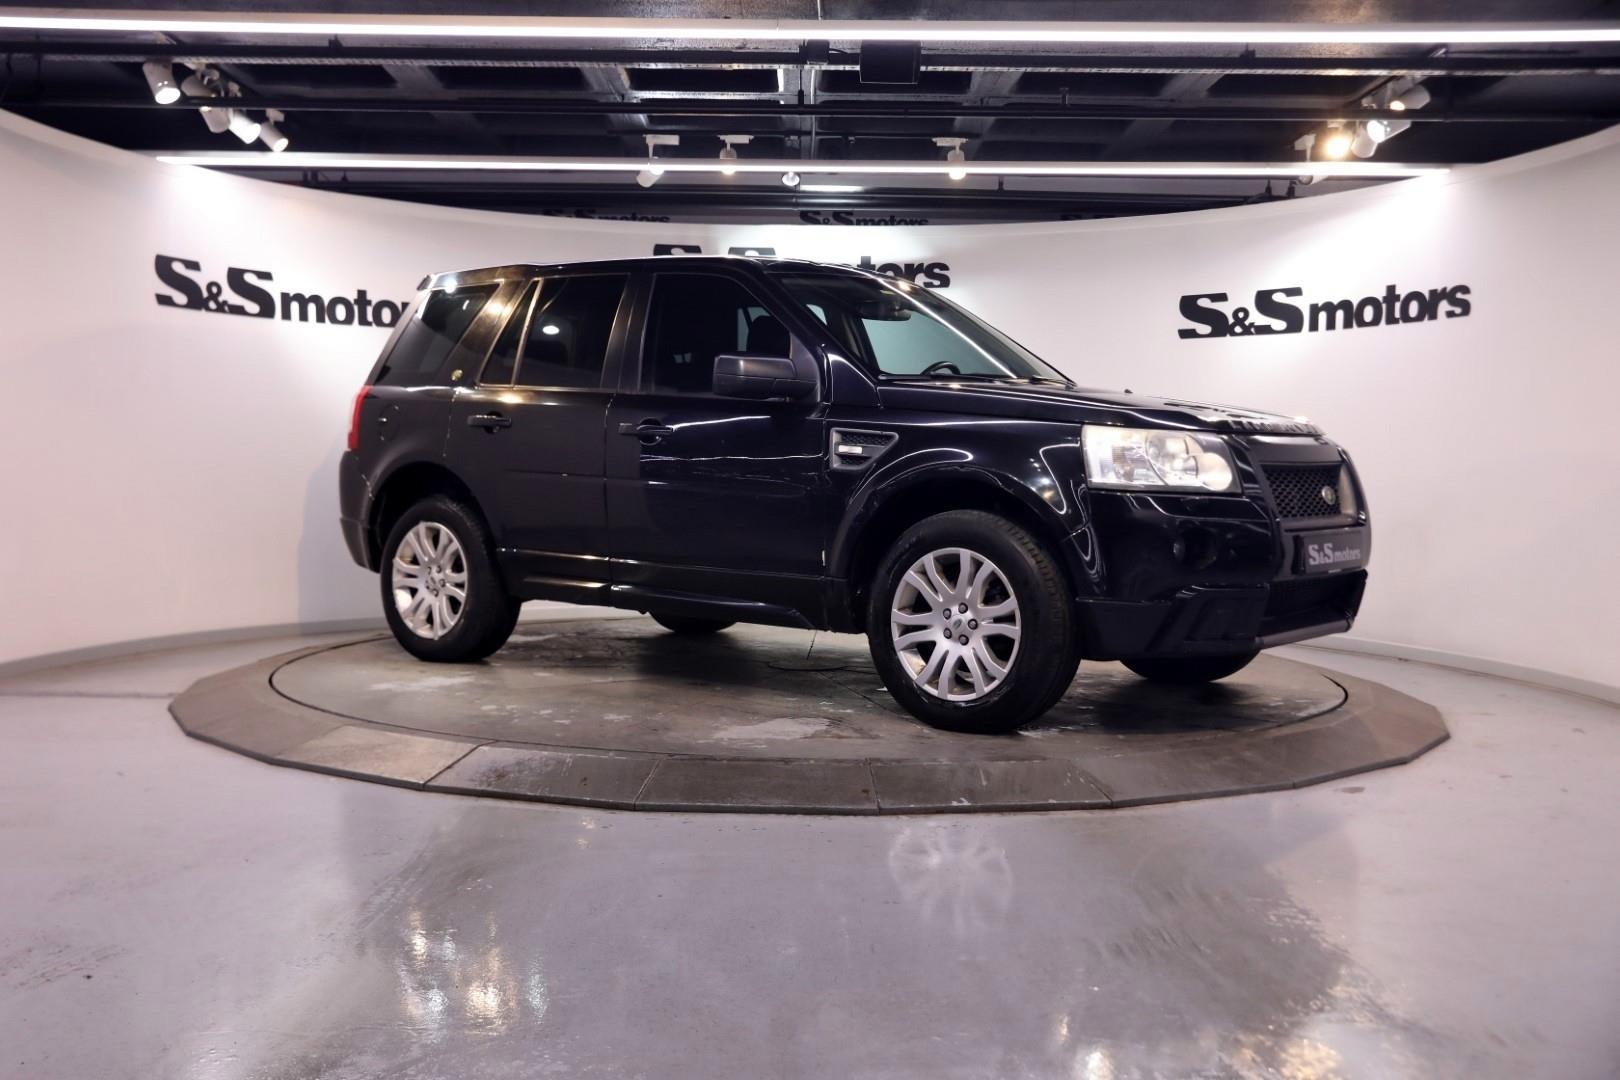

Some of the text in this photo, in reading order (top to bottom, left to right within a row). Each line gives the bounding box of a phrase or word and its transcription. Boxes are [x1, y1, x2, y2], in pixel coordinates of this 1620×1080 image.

[154, 254, 276, 319] S&S
[1178, 284, 1472, 339] S&S motors
